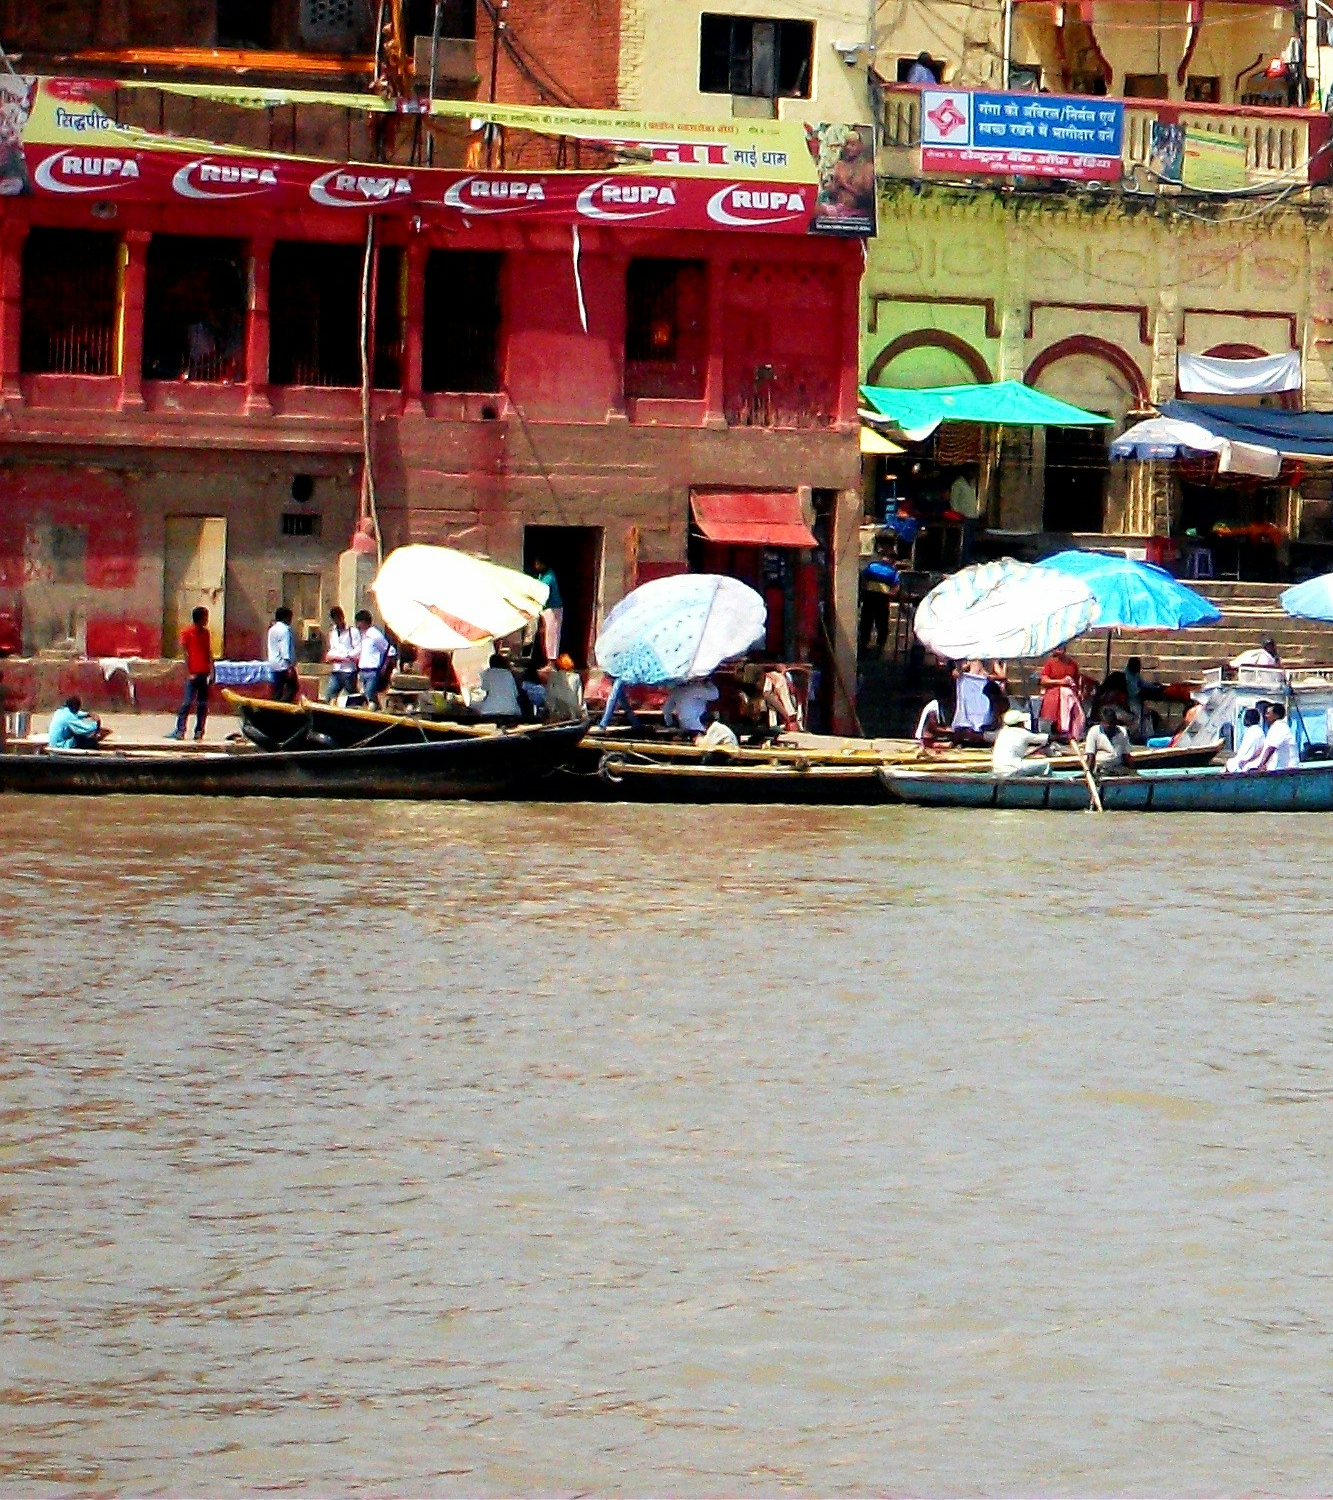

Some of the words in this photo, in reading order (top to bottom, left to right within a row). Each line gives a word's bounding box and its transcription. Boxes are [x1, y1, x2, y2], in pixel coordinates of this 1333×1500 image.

[62, 155, 140, 178] RUPA
[199, 164, 278, 185] RUPA
[469, 179, 547, 201] RUPA
[601, 185, 677, 206] RUPA
[732, 190, 806, 212] RUPA
